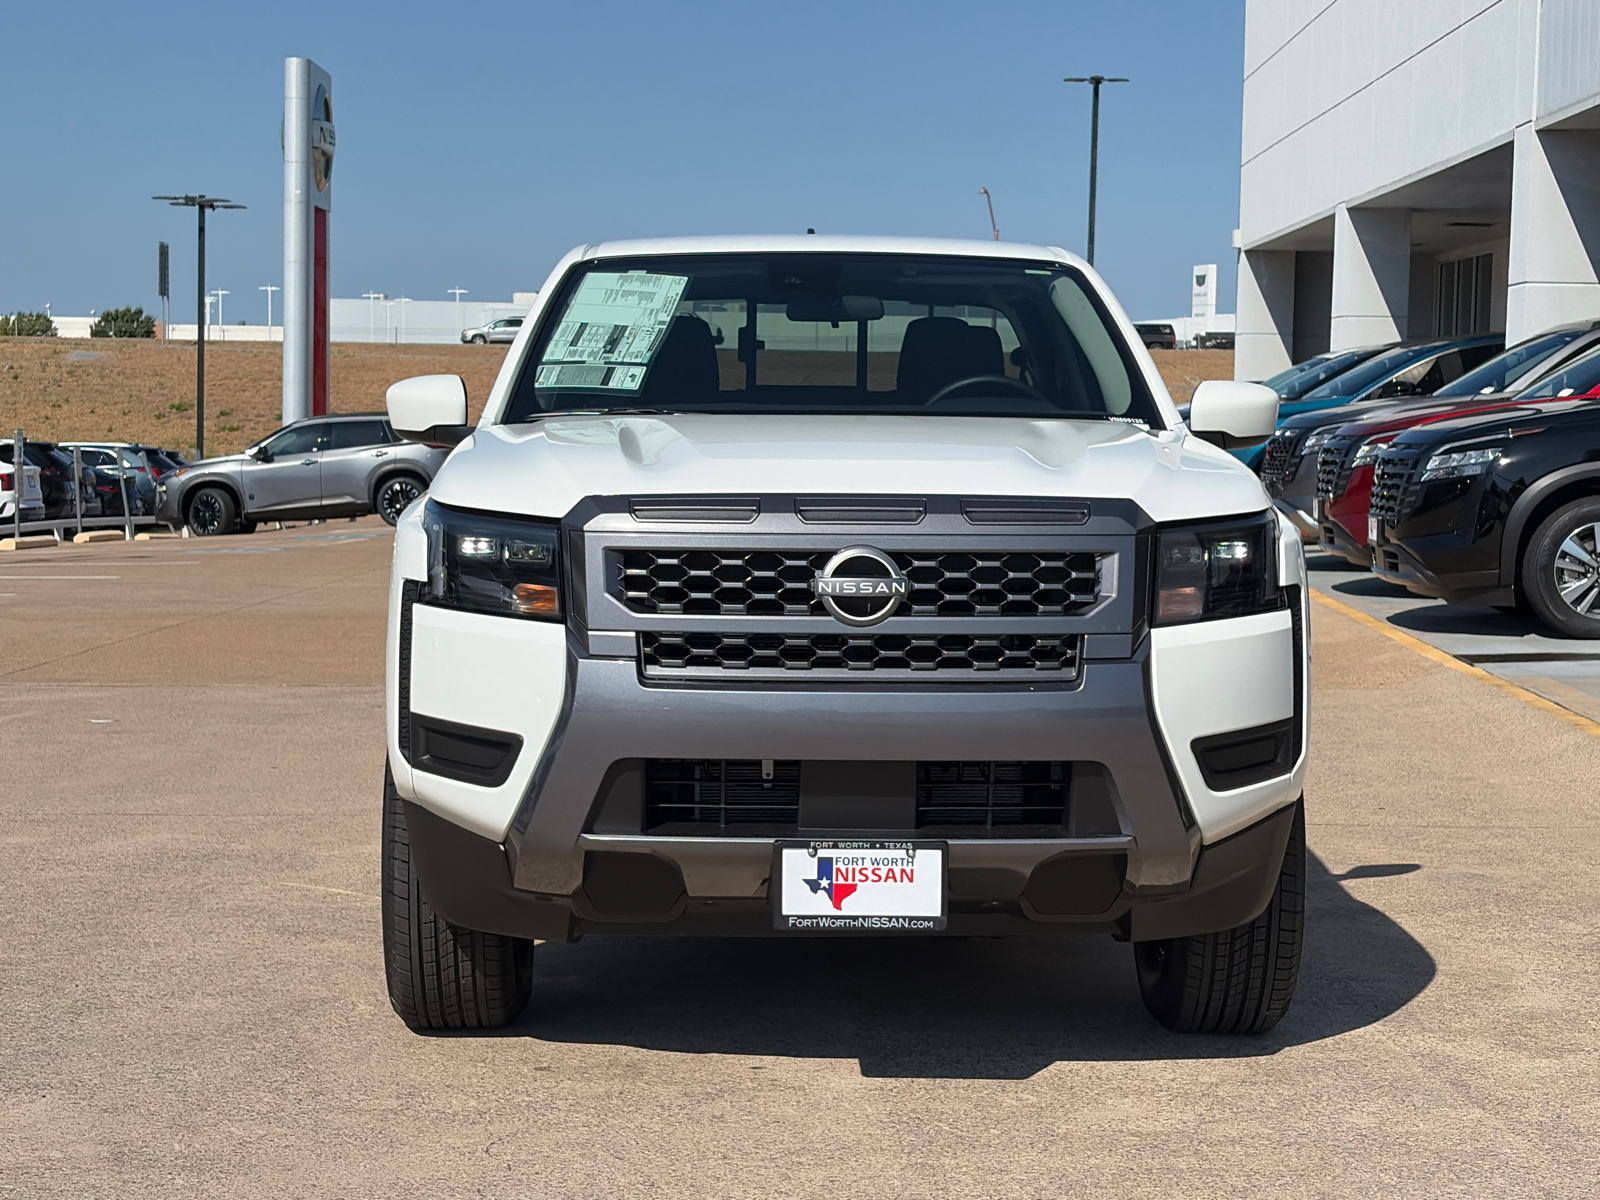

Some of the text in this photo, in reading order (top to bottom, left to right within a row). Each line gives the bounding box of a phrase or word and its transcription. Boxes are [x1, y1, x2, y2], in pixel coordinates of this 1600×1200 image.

[818, 581, 905, 593] NISSAN
[810, 841, 834, 849] FORT
[835, 857, 914, 867] FORT WORTH
[835, 867, 914, 883] NISSAN
